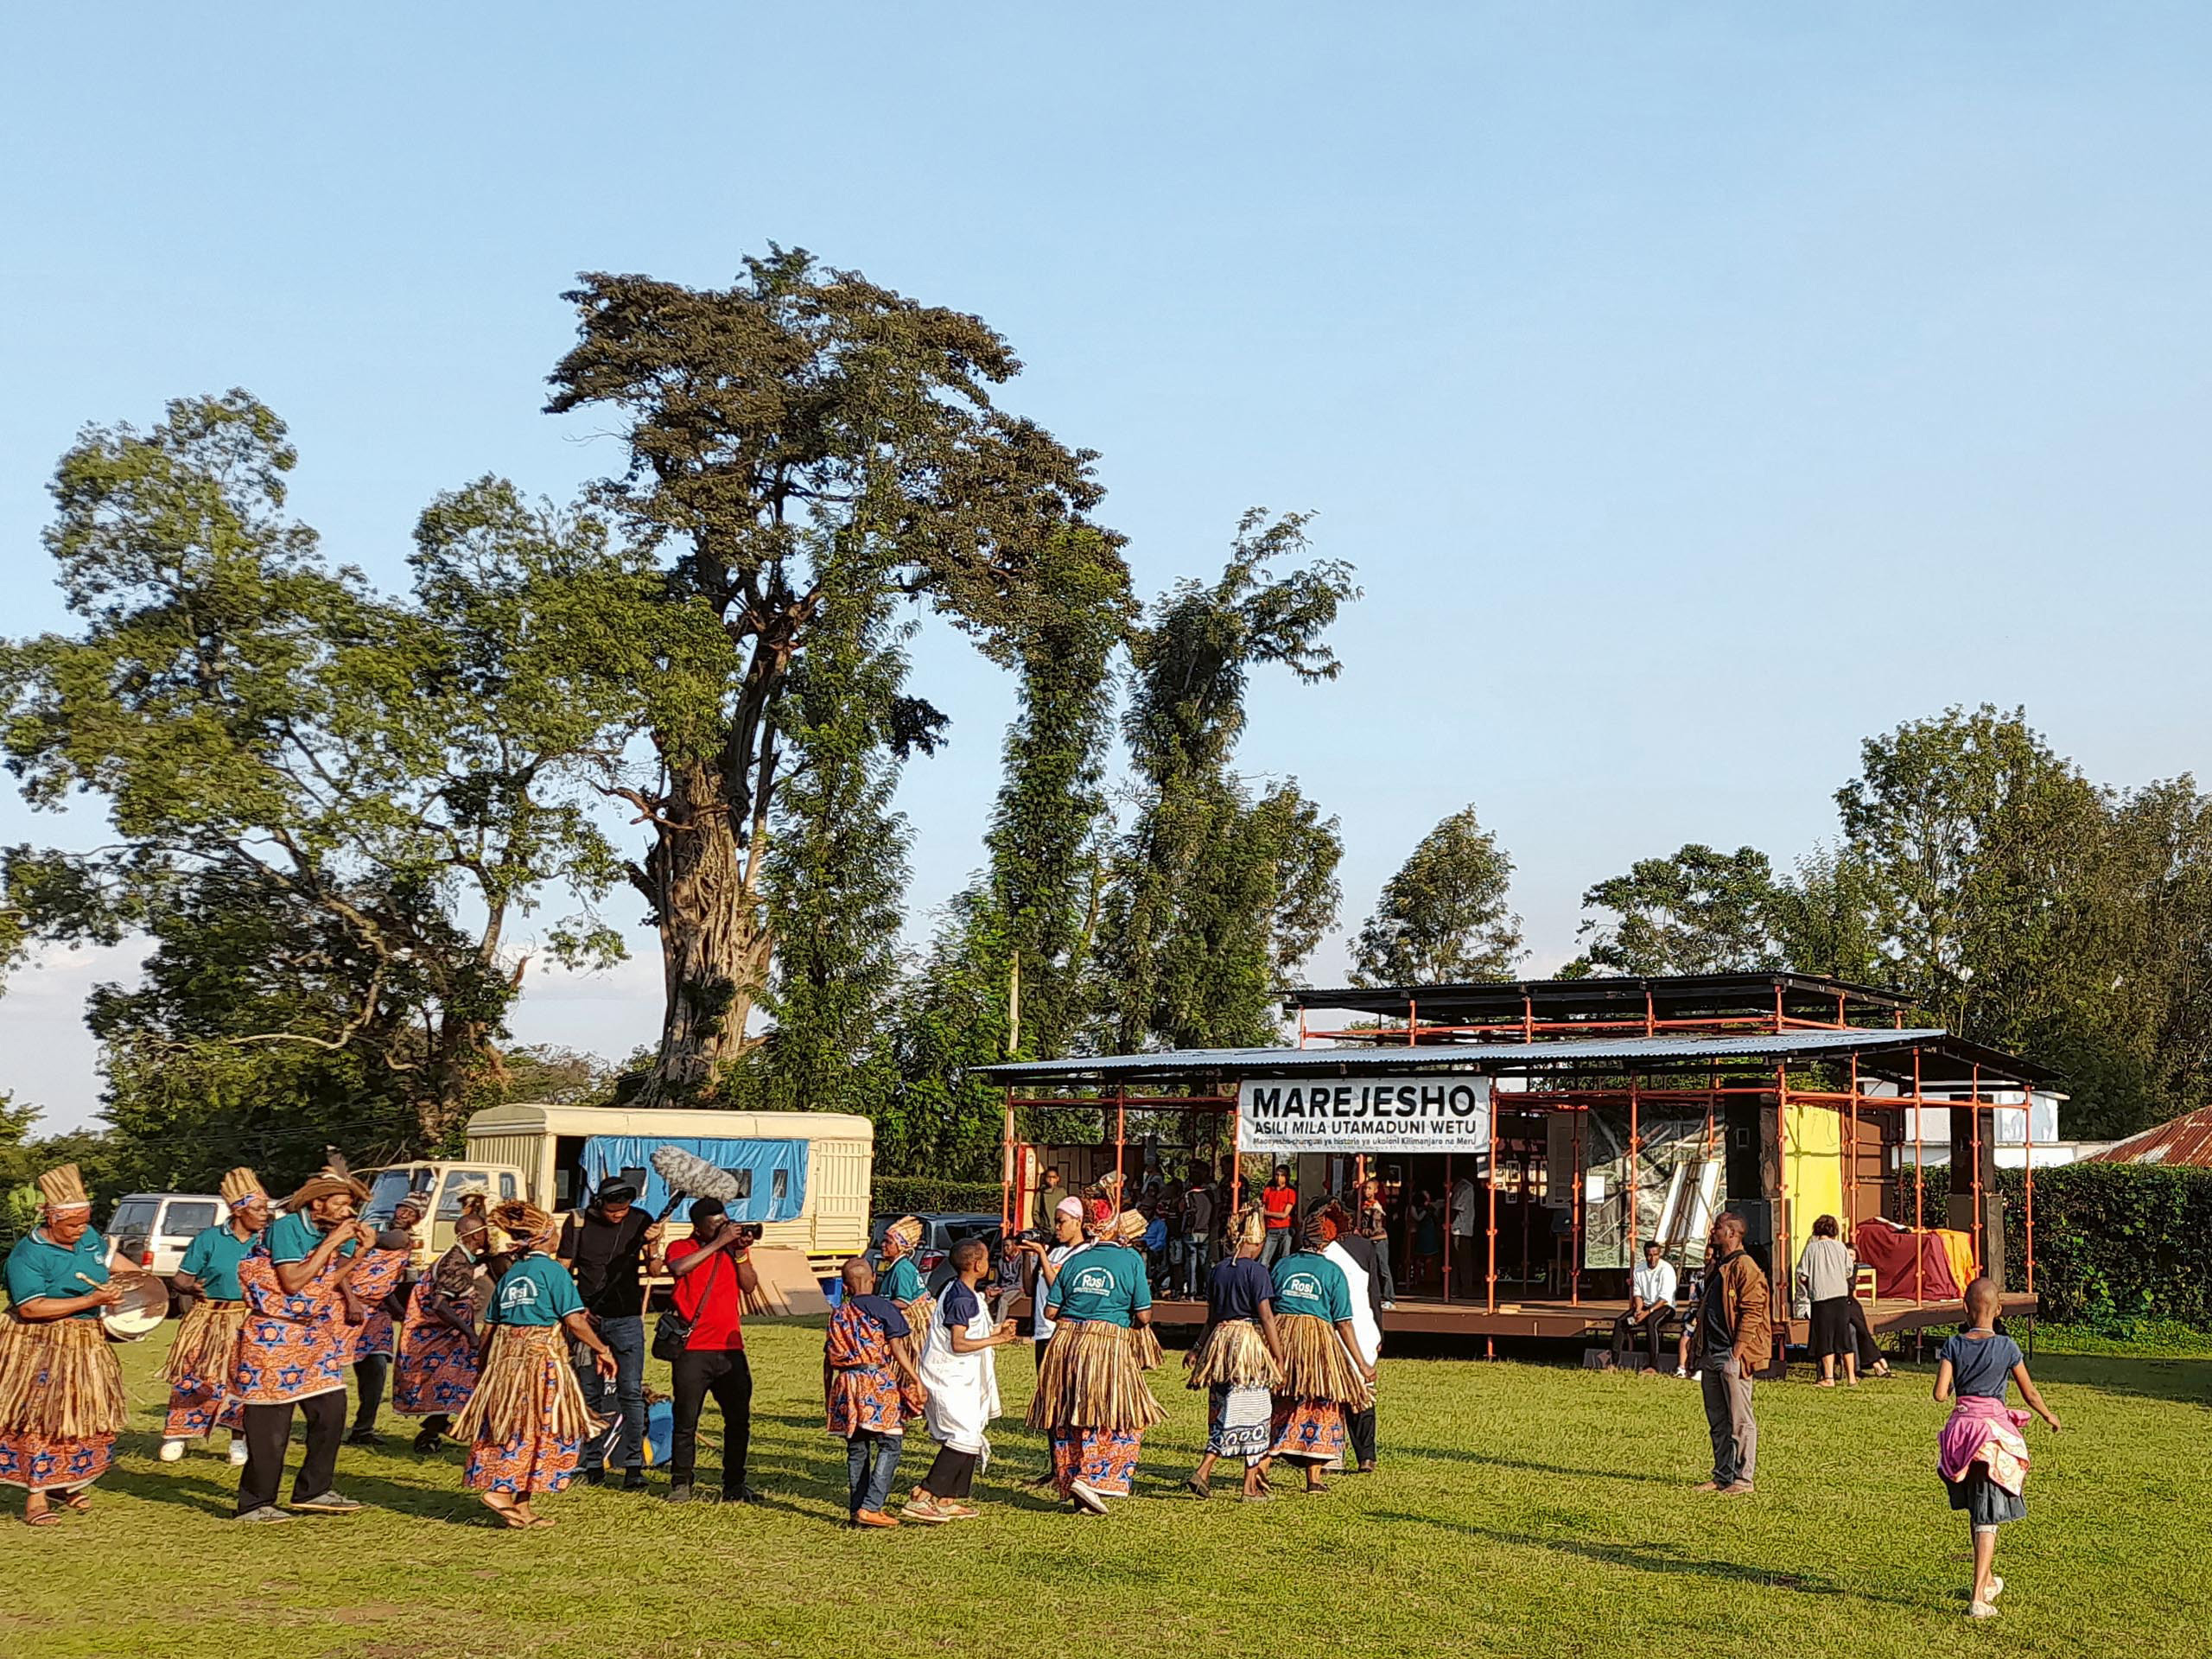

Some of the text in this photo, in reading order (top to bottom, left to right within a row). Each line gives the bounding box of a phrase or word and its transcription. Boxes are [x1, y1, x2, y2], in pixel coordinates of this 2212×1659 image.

[1253, 1085, 1476, 1118] MAREJESHO
[1255, 1120, 1476, 1134] ASILI MILA UTAMADUNI WETU
[1401, 1137, 1443, 1147] Kilimanjaro
[1082, 1274, 1107, 1288] Rosi
[1291, 1279, 1314, 1294] Rosi
